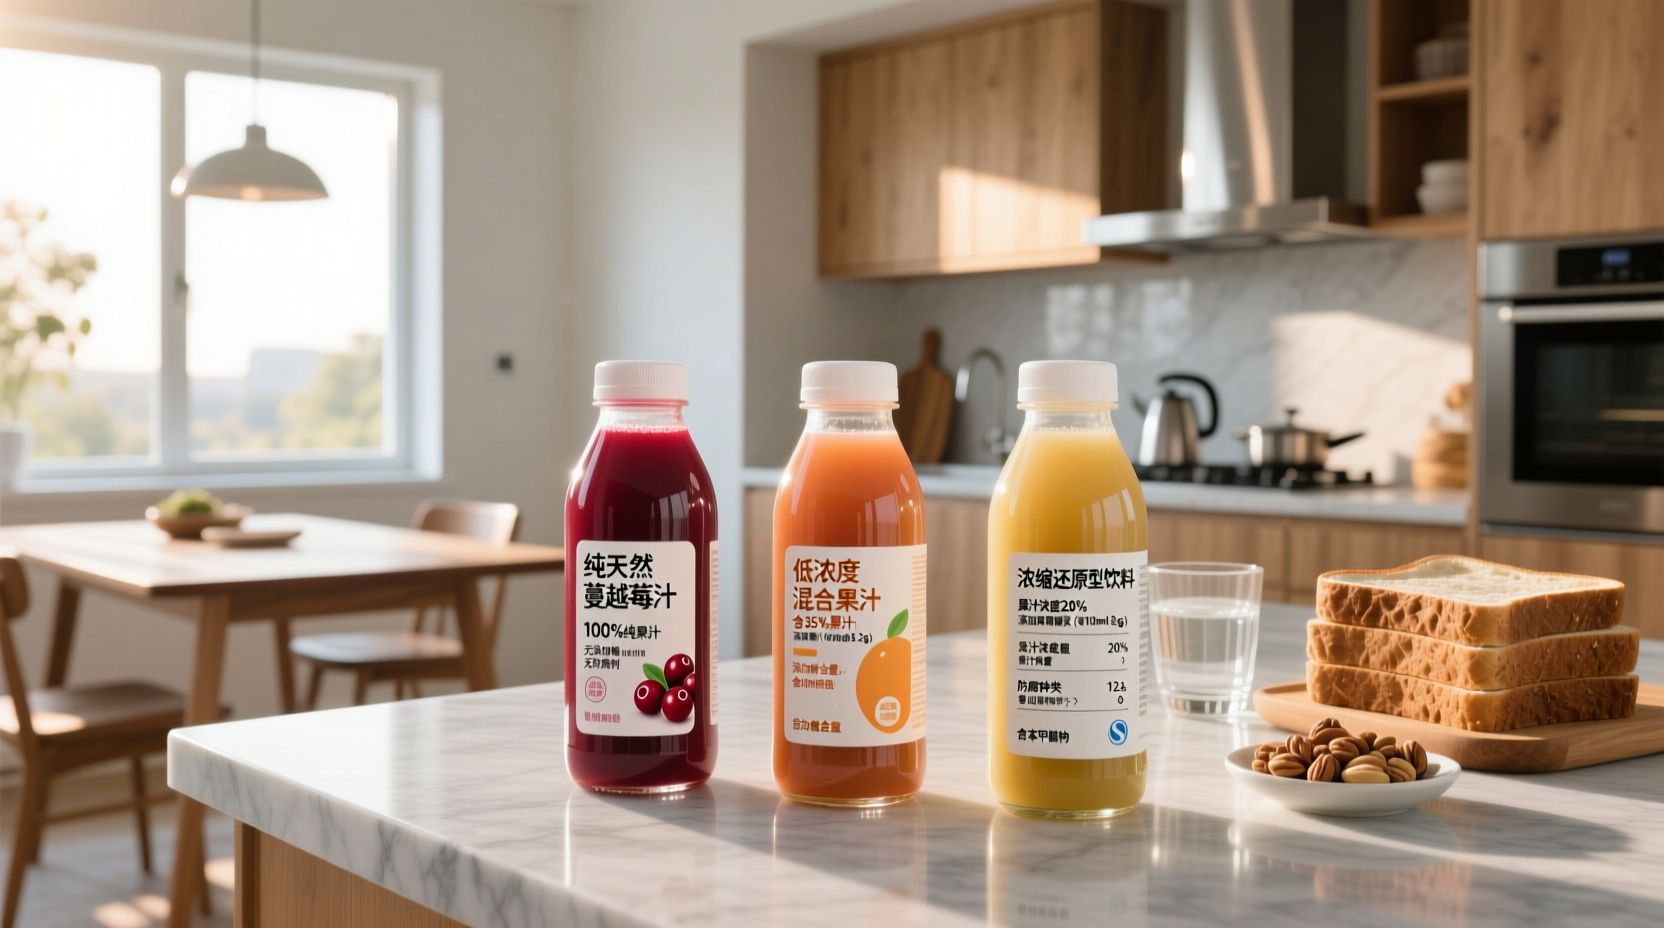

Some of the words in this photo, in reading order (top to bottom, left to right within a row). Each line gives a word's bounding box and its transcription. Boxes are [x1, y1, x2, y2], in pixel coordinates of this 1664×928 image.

[584, 552, 653, 579] 纯天然
[793, 558, 860, 583] 低浓度
[1017, 567, 1135, 590] 浓缩还原型饮料
[584, 582, 677, 609] 蔓越莓汁
[793, 586, 881, 612] 混合果汁
[584, 621, 661, 639] 100%纯果汁
